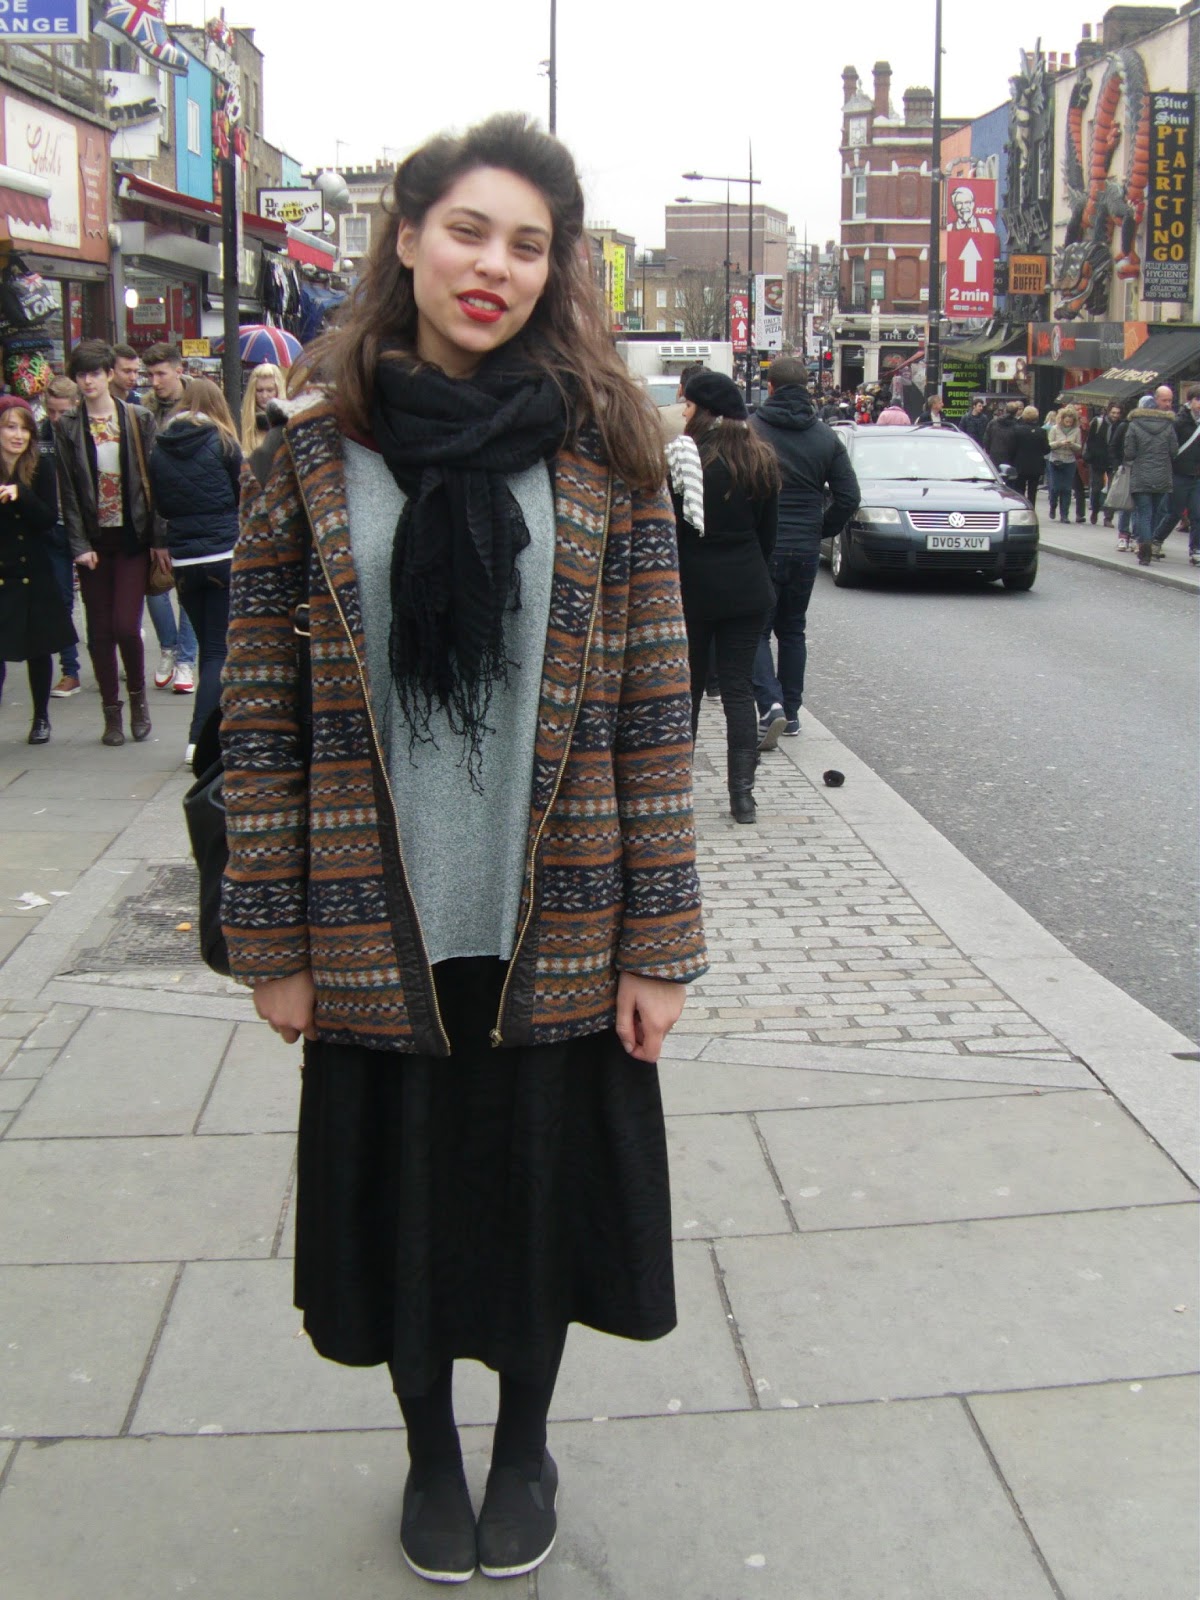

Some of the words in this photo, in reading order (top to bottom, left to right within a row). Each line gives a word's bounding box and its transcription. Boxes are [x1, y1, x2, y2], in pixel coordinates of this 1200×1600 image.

[1154, 96, 1189, 109] Blue
[1154, 111, 1190, 126] Skin
[1153, 125, 1172, 261] PIERCING
[1170, 127, 1188, 261] TATTOO
[265, 203, 320, 218] Martens
[1013, 263, 1042, 275] ORIENTAL
[1146, 270, 1188, 278] HYGIENIC
[1013, 276, 1042, 291] BUFFET
[950, 288, 960, 301] 2
[961, 289, 989, 302] min
[932, 537, 961, 548] DV05
[963, 537, 985, 548] XUY
